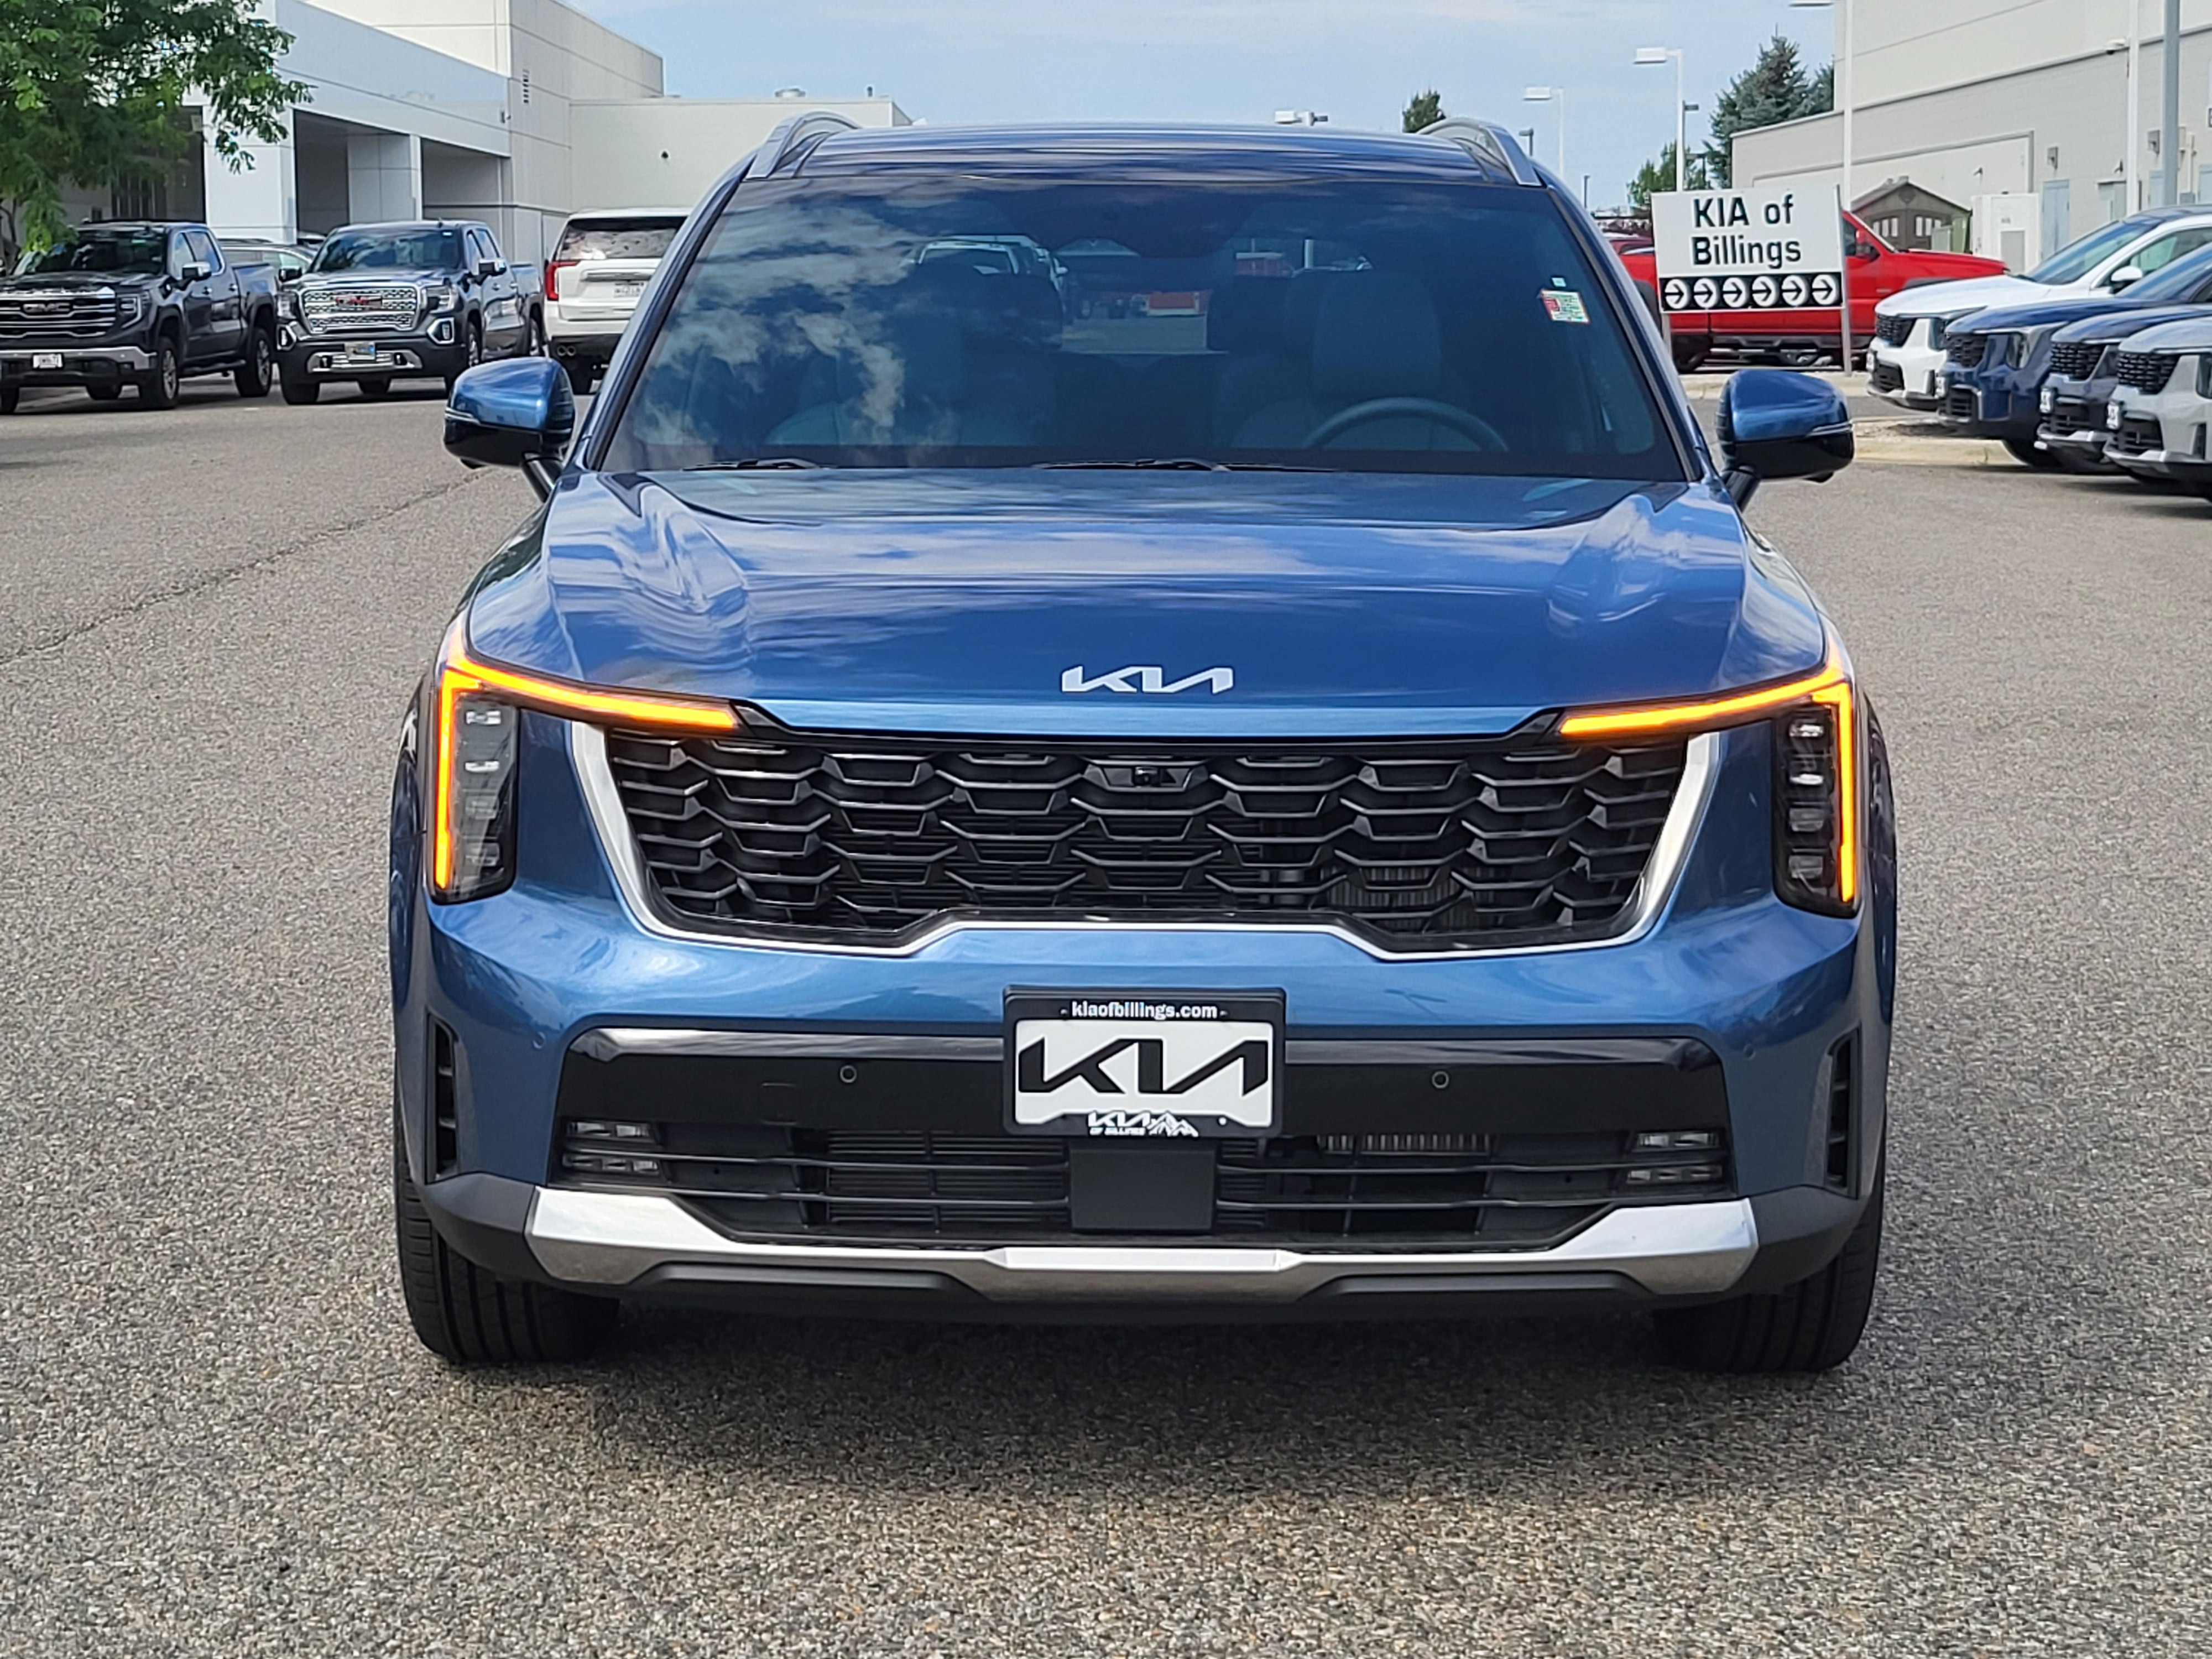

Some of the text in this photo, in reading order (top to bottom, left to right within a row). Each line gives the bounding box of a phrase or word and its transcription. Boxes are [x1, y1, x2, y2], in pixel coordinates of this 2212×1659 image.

[1693, 194, 1794, 228] KIA of
[1691, 234, 1802, 269] Billings
[1061, 665, 1234, 695] KIA
[1018, 1036, 1269, 1097] KIA
